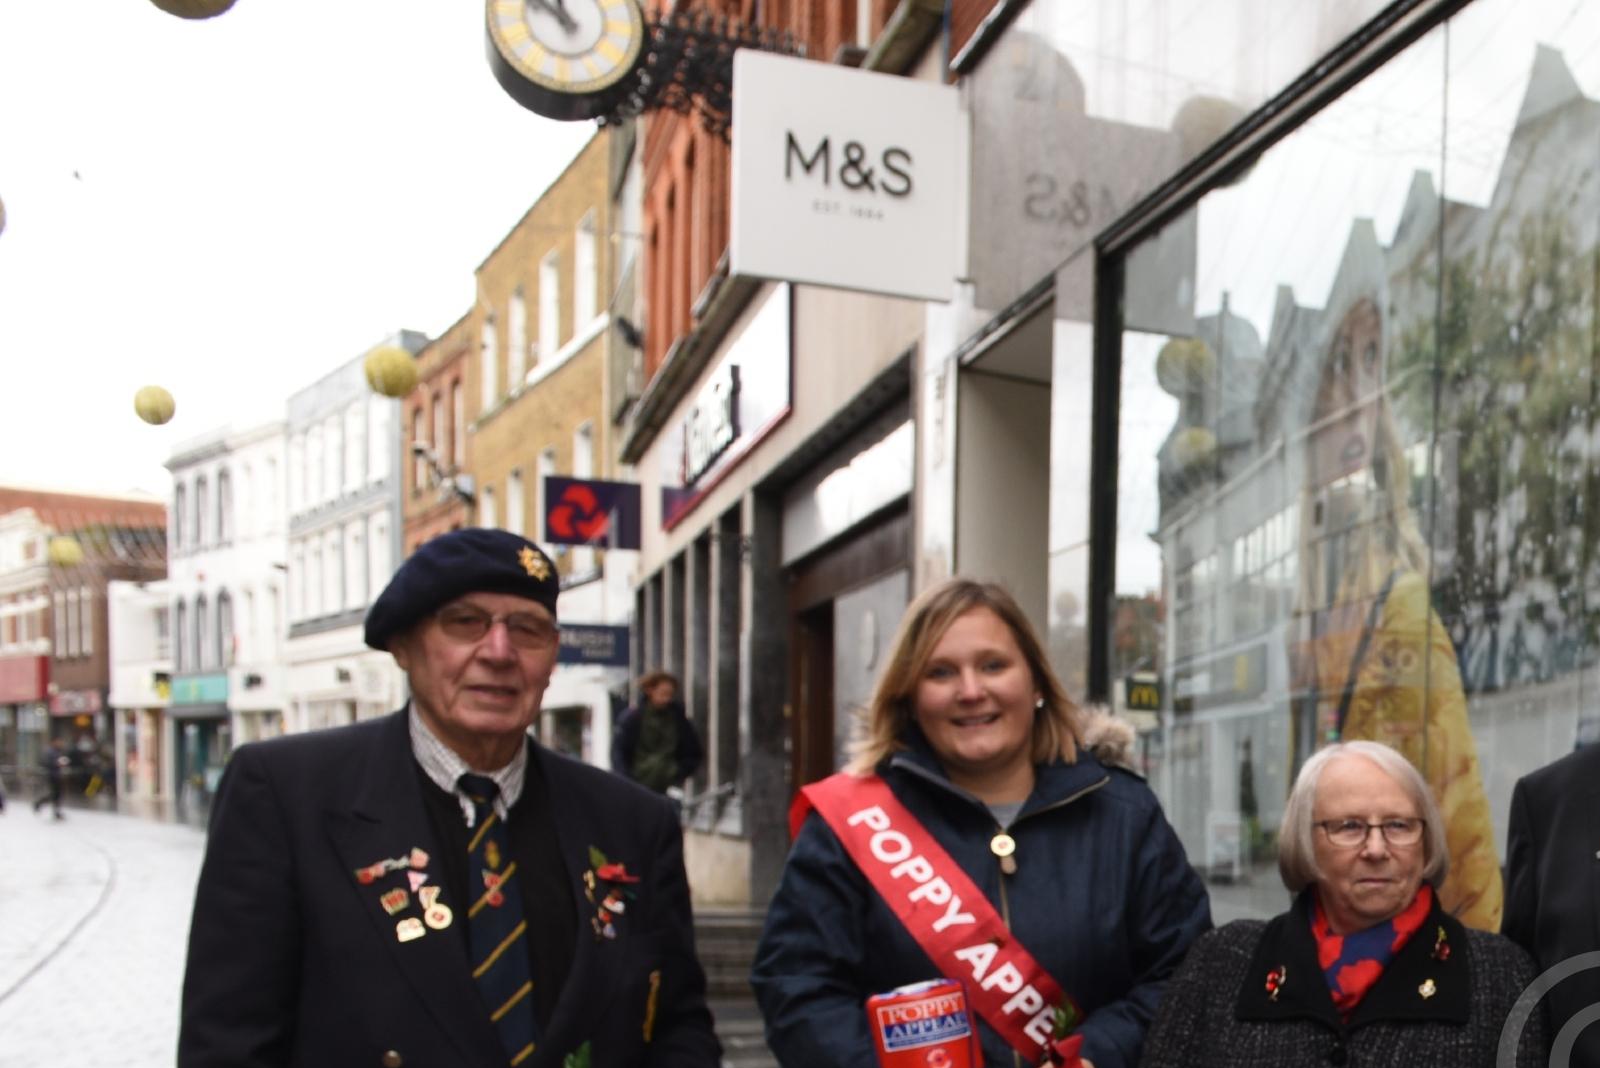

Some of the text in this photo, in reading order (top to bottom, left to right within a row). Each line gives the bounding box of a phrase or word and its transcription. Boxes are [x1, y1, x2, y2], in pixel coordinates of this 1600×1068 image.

[785, 130, 913, 198] M&S
[847, 806, 976, 933] POPPY
[887, 997, 961, 1025] POPPY
